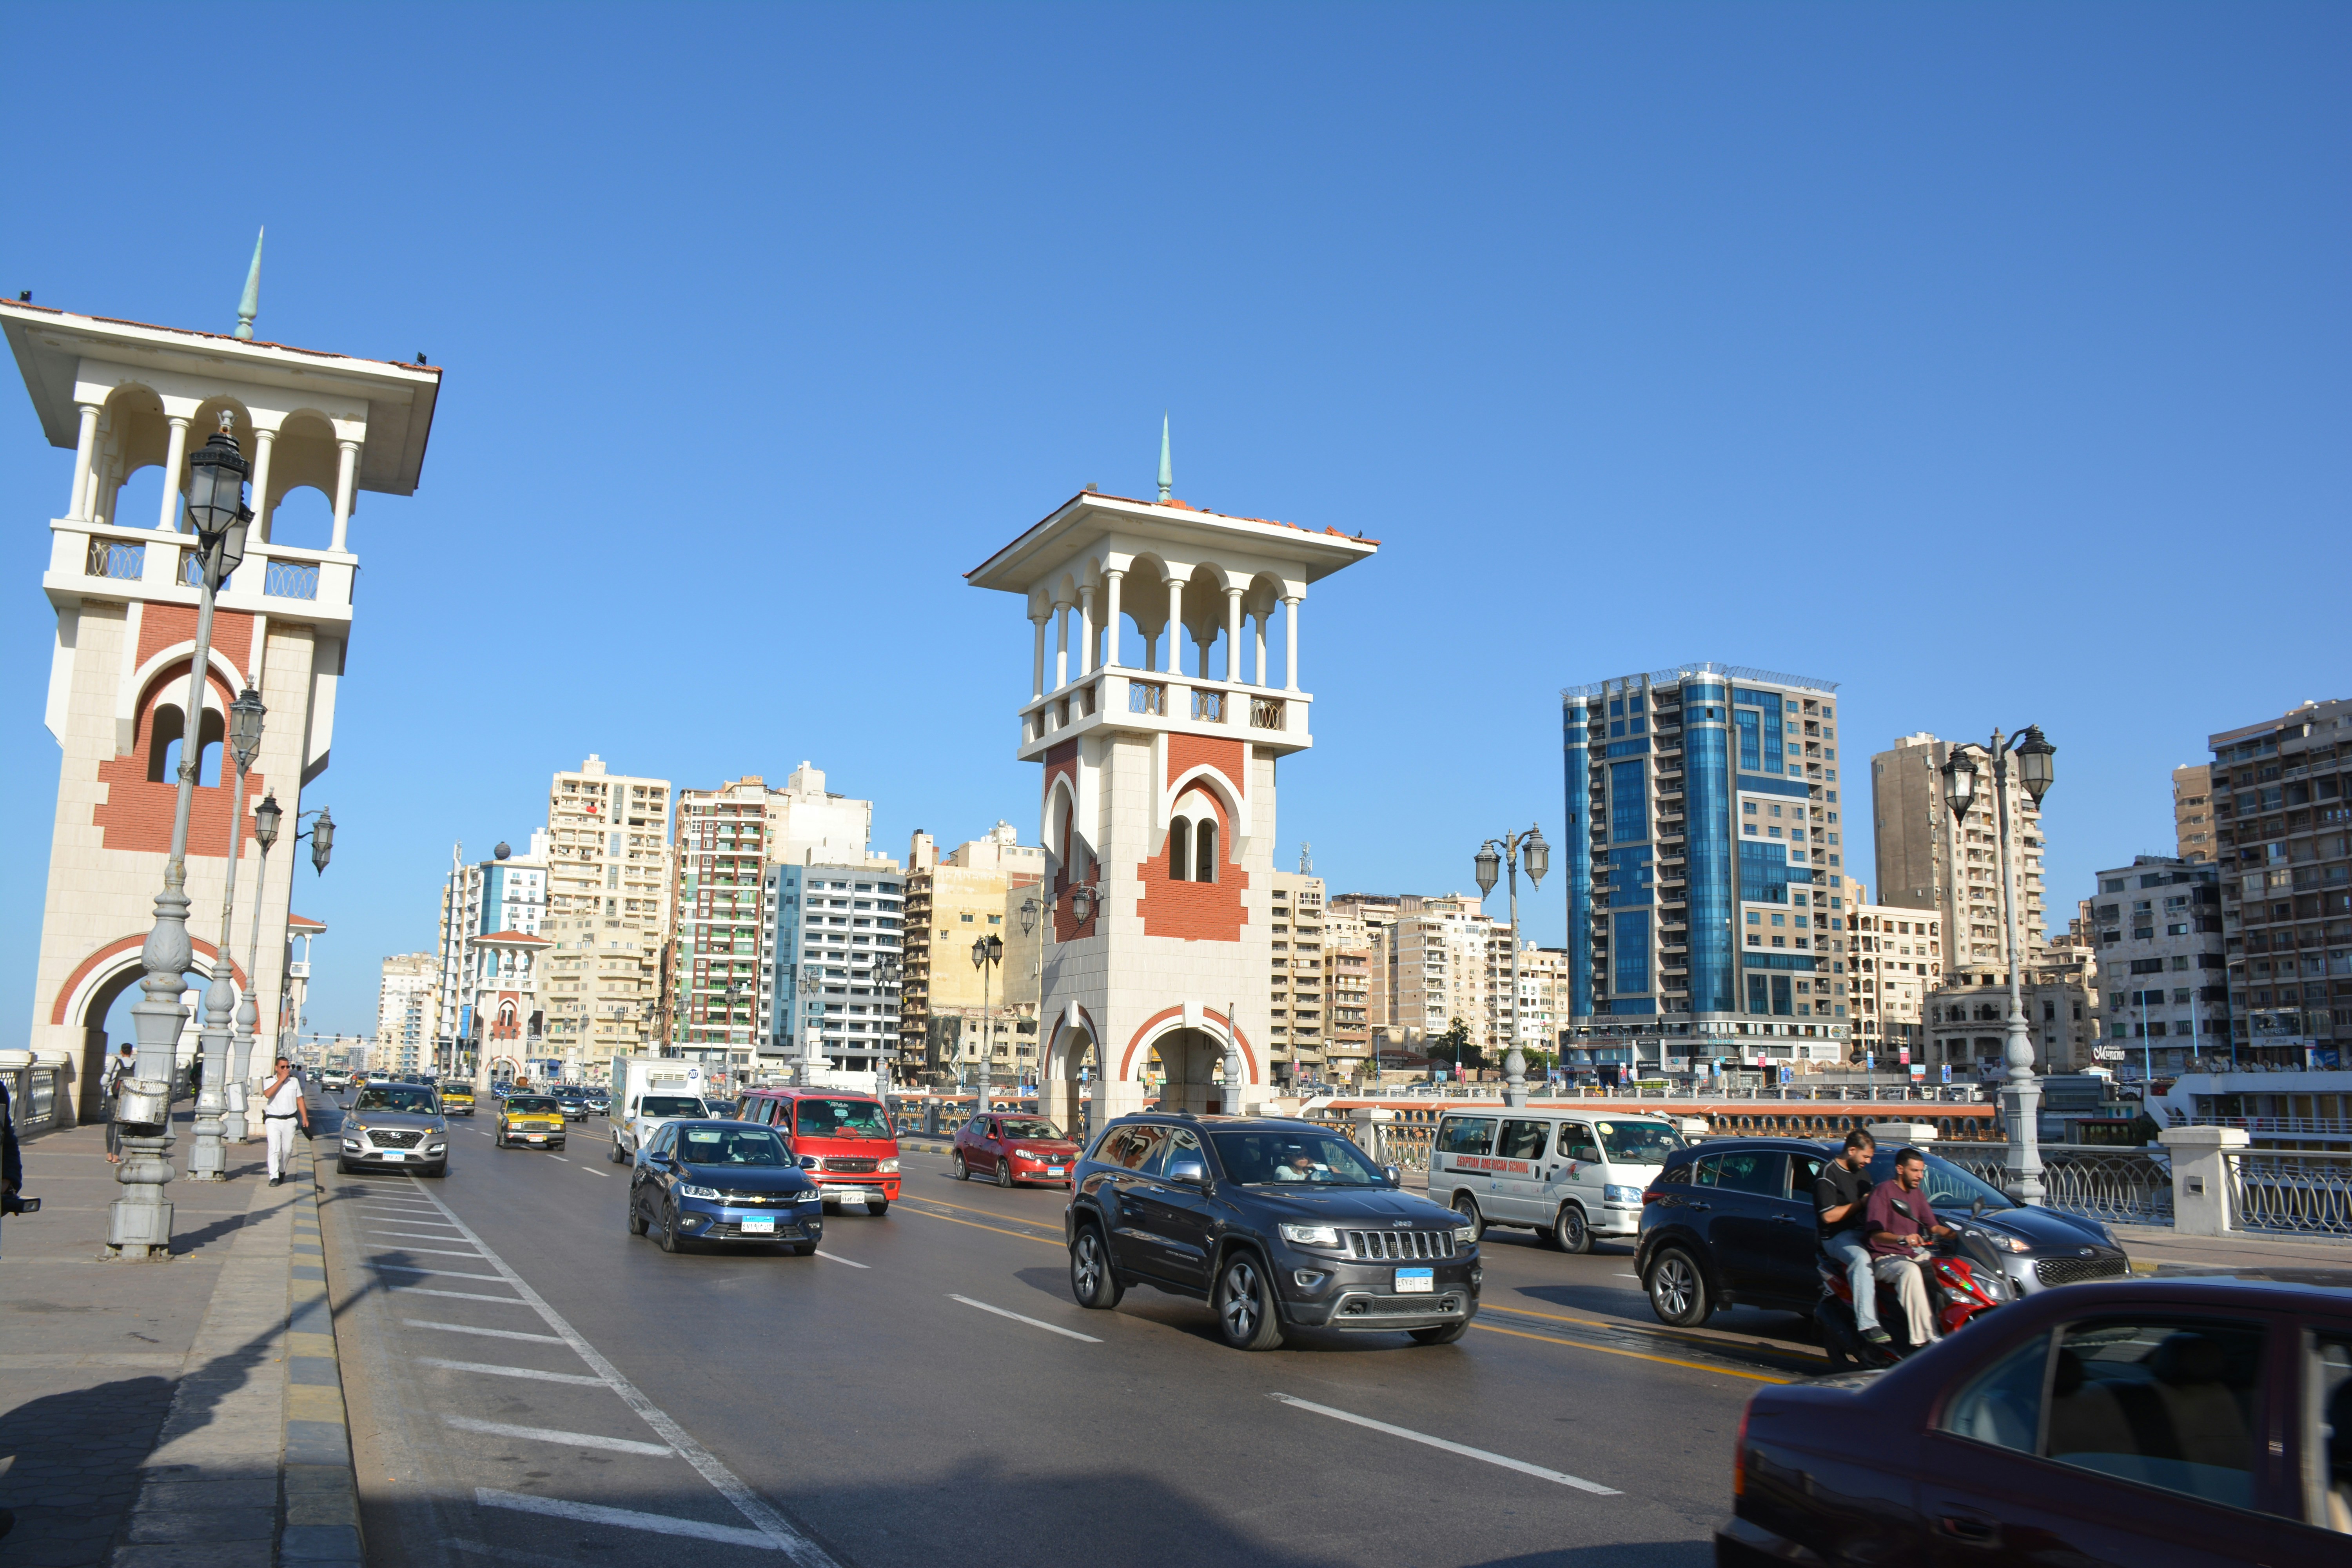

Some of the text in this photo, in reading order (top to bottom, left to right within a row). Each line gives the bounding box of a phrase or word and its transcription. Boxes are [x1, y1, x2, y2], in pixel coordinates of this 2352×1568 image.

[2093, 1045, 2125, 1060] Murano
[1457, 1156, 1529, 1174] EGYPTIAN AMERICAN SCHOOL
